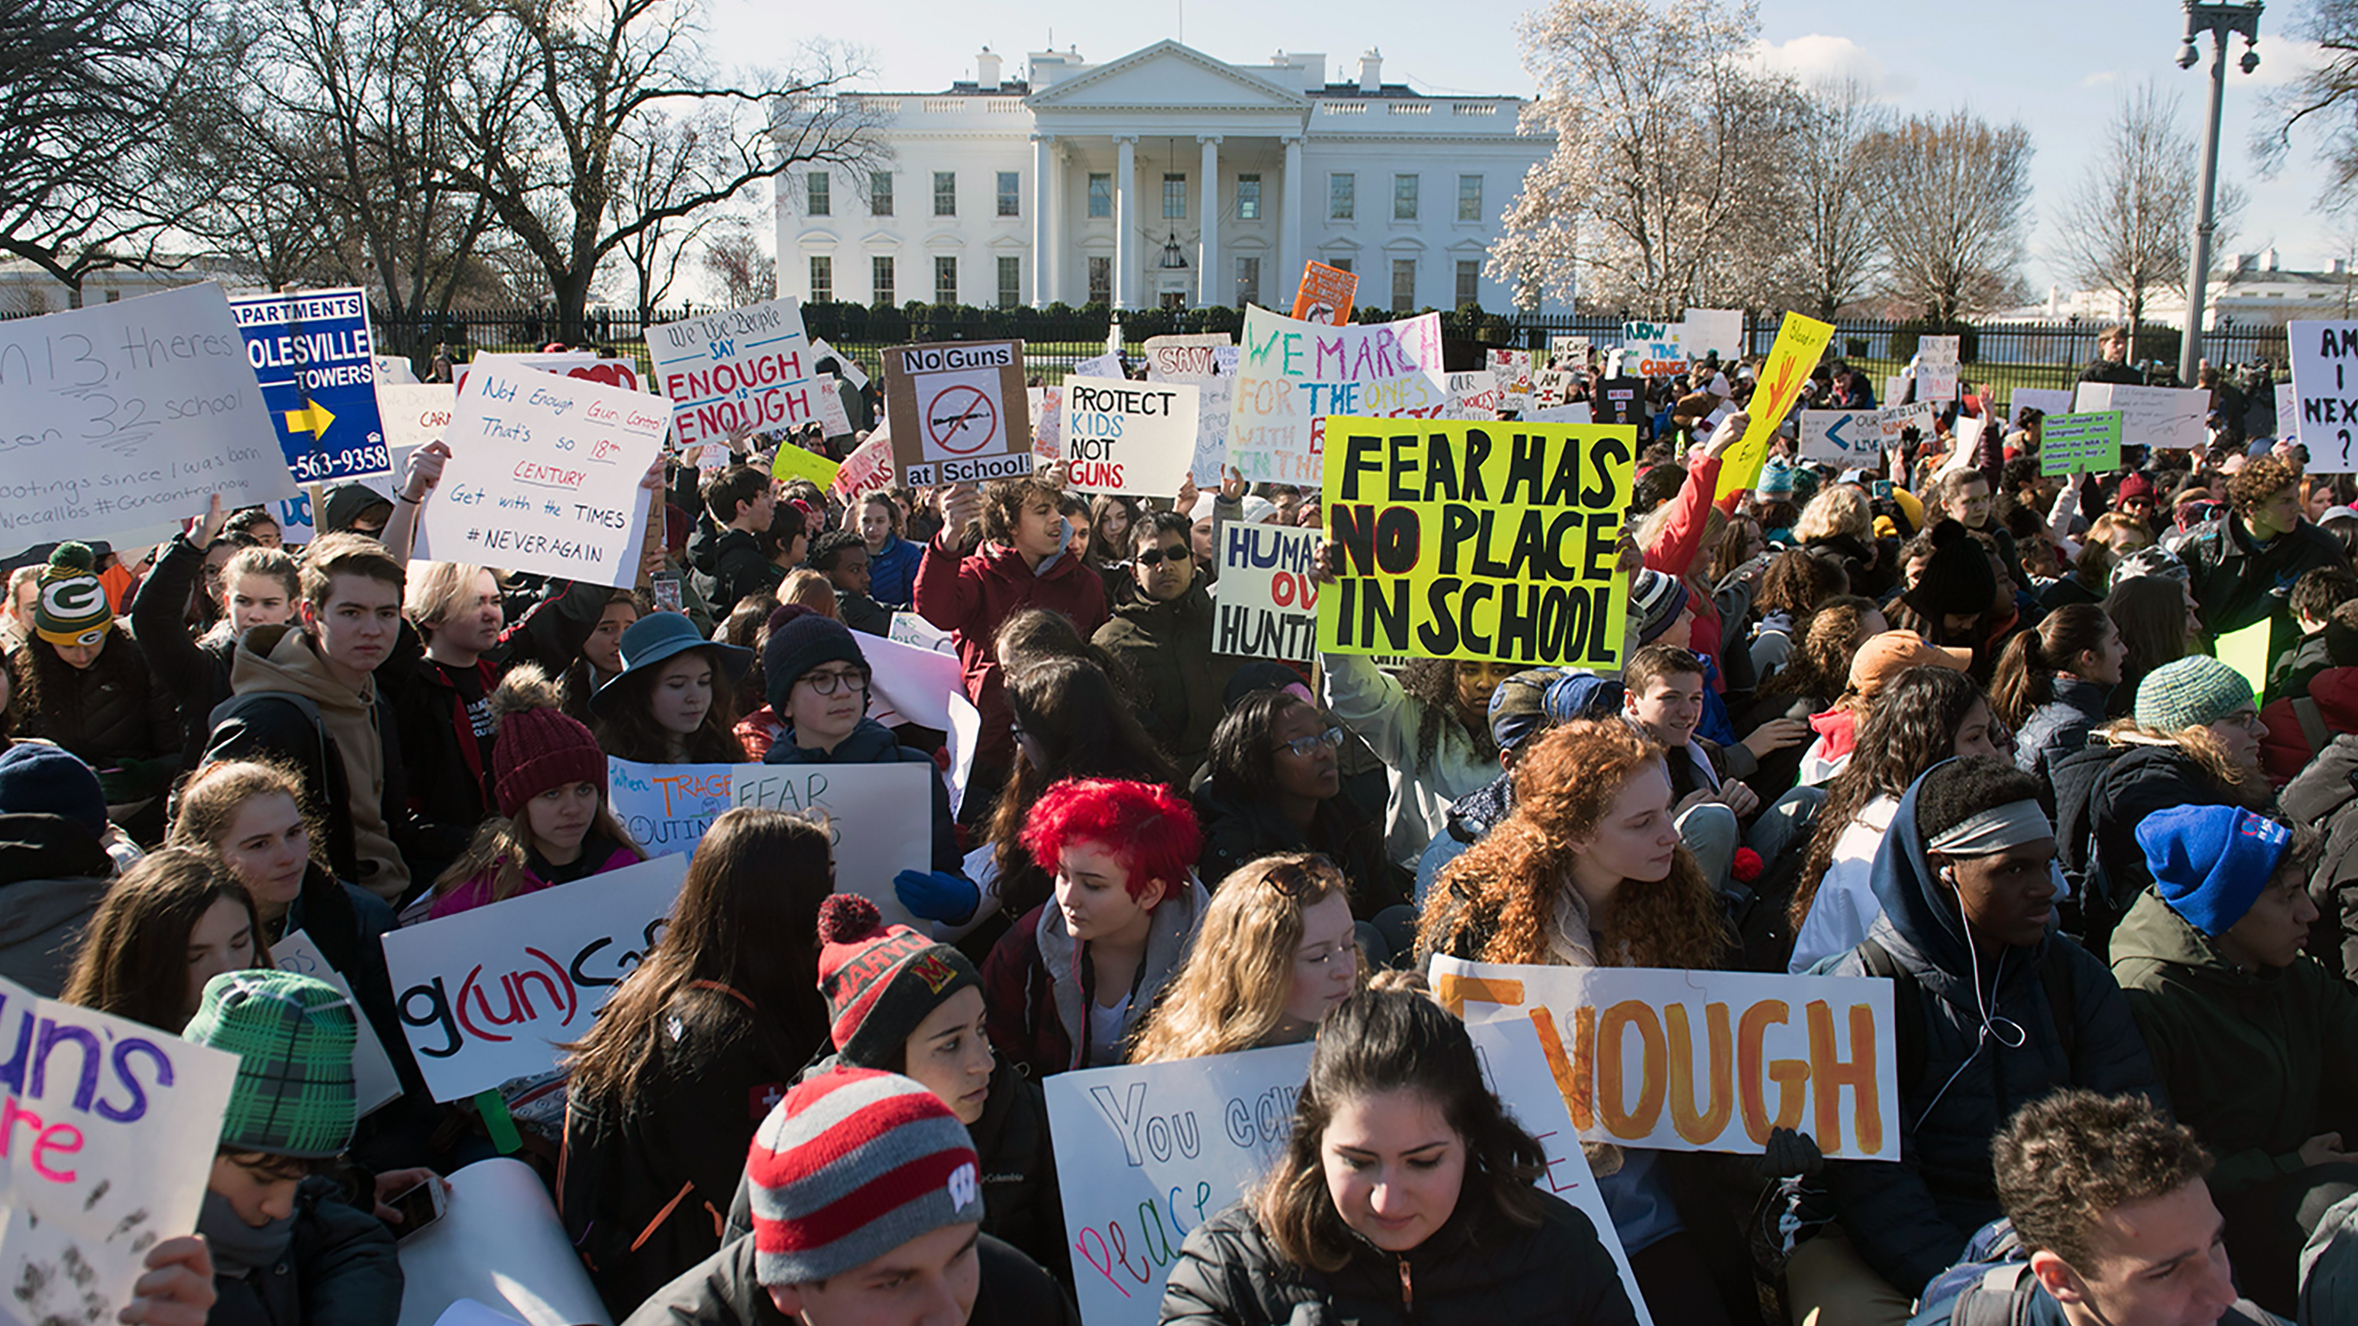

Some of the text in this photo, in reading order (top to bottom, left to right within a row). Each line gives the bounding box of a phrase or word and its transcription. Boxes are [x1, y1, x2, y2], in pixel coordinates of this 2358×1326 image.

[729, 305, 781, 335] People
[1626, 322, 1667, 340] NOW
[121, 326, 233, 369] theres
[247, 330, 370, 369] OLESVILLE
[709, 339, 735, 360] SAY
[1249, 321, 1304, 376] WE
[1316, 315, 1440, 380] MARCH
[1649, 343, 1680, 359] TIME
[2320, 328, 2358, 359] AM
[904, 349, 1009, 371] No Guns
[1640, 359, 1689, 376] CHANGE
[294, 364, 373, 391] TOWERS
[667, 351, 802, 403] ENOUGH
[1450, 374, 1477, 392] OUR
[1540, 374, 1561, 387] AM
[2336, 363, 2343, 392] I
[481, 376, 519, 403] Not
[528, 388, 574, 415] Enough
[587, 400, 620, 420] Gun
[1073, 386, 1176, 416] PROTECT
[1238, 377, 1296, 416] FOR
[1299, 382, 1360, 415] THE
[1364, 378, 1428, 410] ONES
[1462, 389, 1495, 412] VOICES
[80, 388, 243, 439] 32 school
[676, 388, 811, 444] ENOUGH
[1071, 413, 1124, 438] KIDS
[1855, 415, 1879, 427] OUR
[481, 417, 531, 443] That's
[555, 437, 575, 451] so
[1070, 439, 1115, 460] NOT
[1235, 426, 1296, 446] WITH
[1855, 439, 1880, 453] LIVE
[2337, 428, 2351, 467] ?
[0, 478, 91, 504] ootings
[99, 469, 162, 487] since
[184, 455, 223, 474] was
[228, 446, 262, 462] born
[513, 460, 587, 488] CENTURY
[853, 459, 893, 499] GUNS
[909, 454, 1030, 485] at School!
[1231, 450, 1323, 480] IN THE
[1341, 429, 1492, 502] FEAR
[1501, 433, 1631, 509] HAS
[450, 483, 625, 529] Get with the TIMES
[1330, 503, 1619, 582] NO PLACE
[1336, 577, 1617, 664] IN SCHOOL
[652, 774, 732, 817] TRAGE
[739, 773, 834, 812] FEAR
[1090, 1082, 1200, 1167] You
[1075, 1181, 1211, 1298] peace
